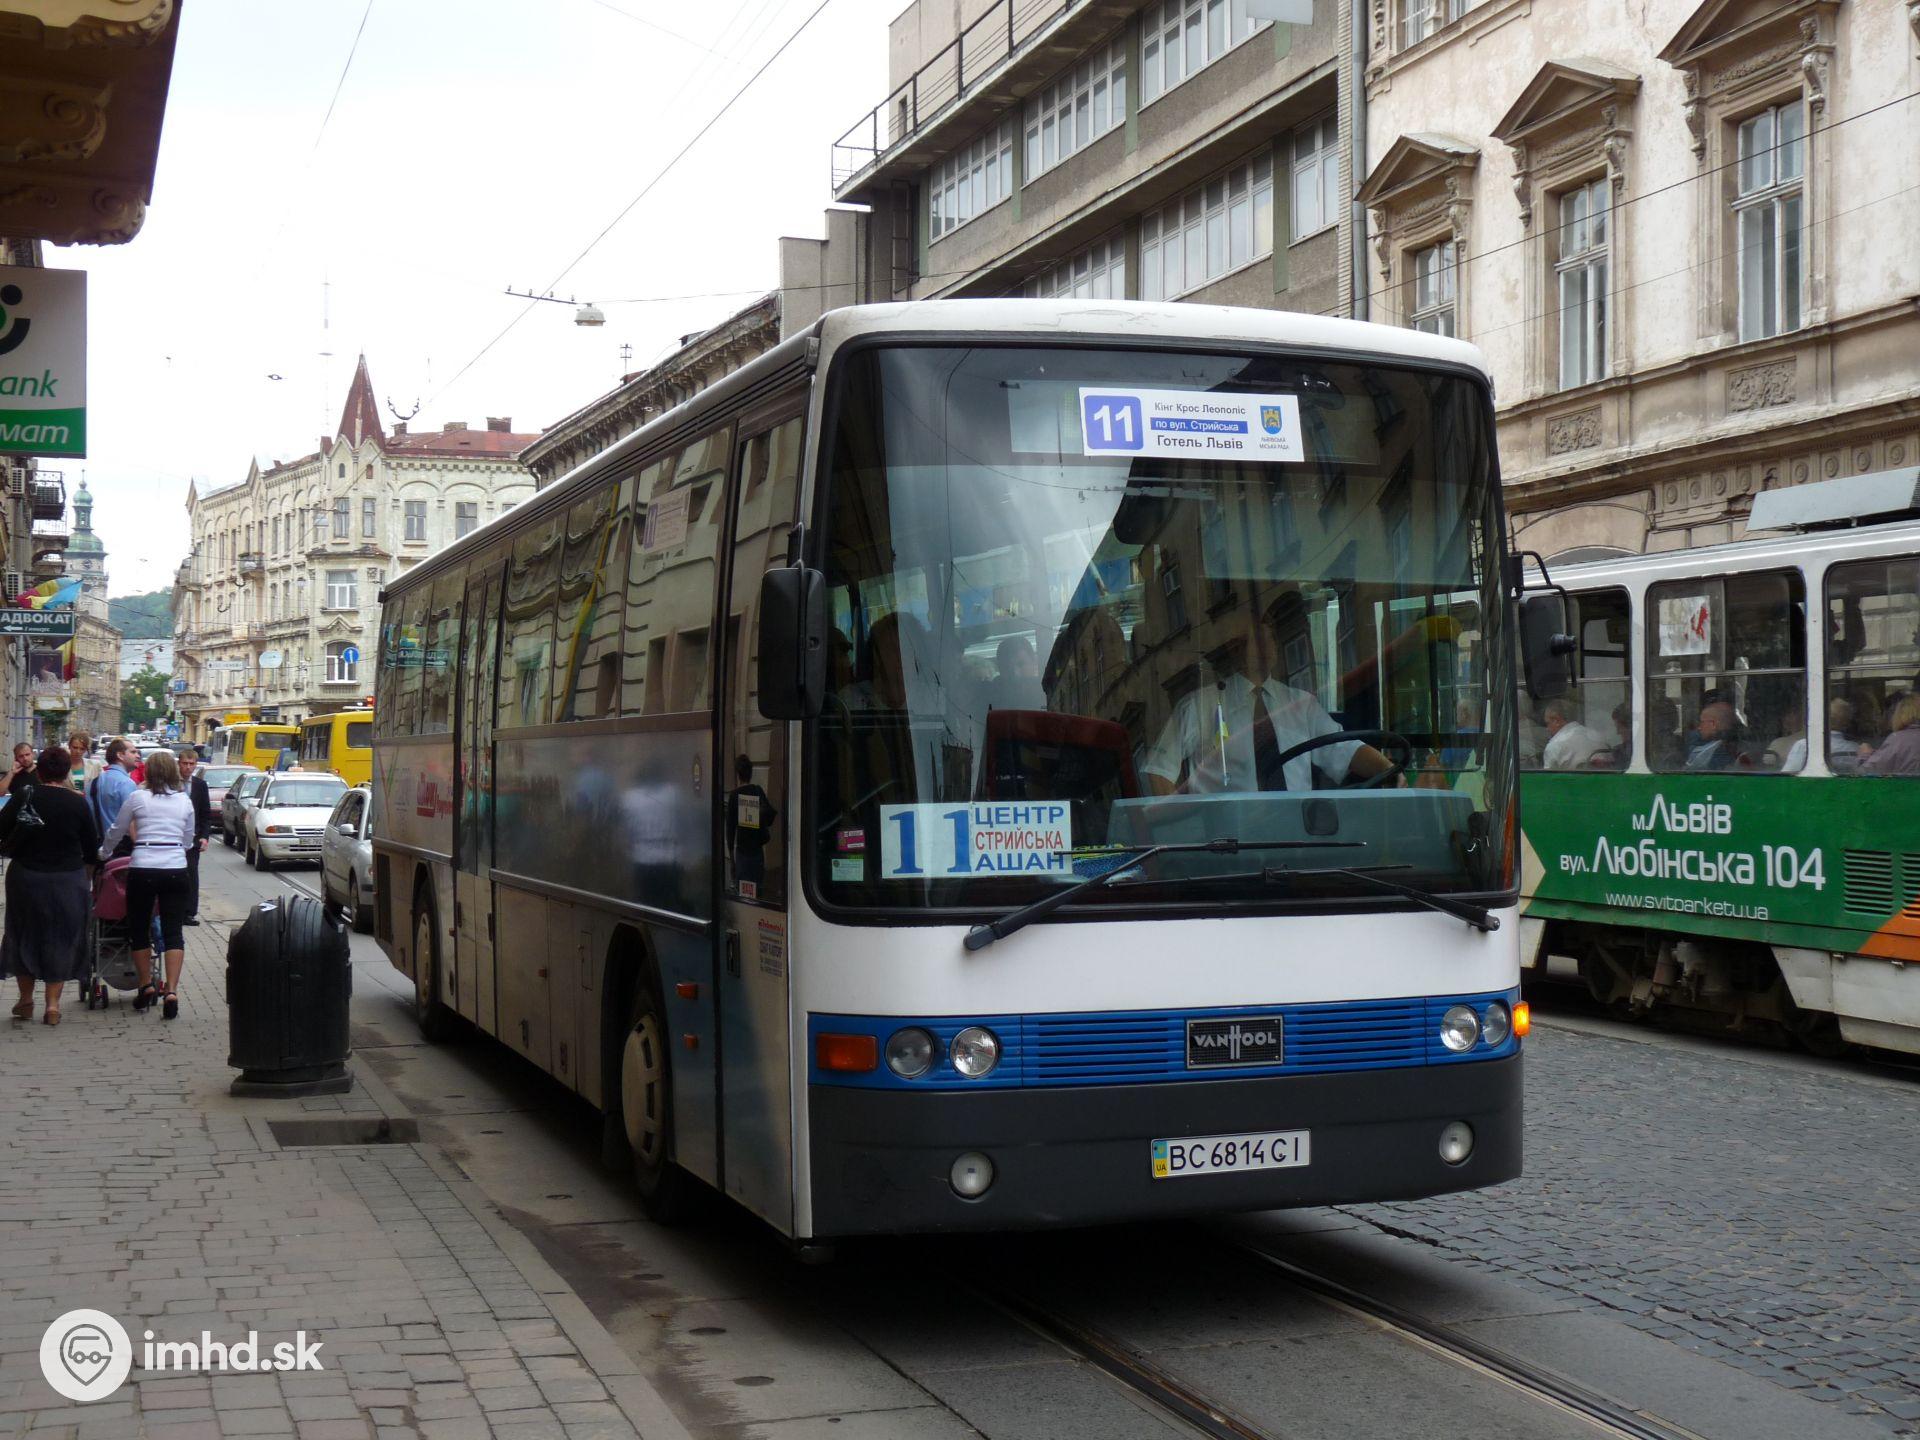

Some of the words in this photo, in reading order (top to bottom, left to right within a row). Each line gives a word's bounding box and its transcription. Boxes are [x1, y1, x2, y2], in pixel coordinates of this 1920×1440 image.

[1155, 402, 1173, 411] Кінг
[1176, 404, 1200, 413] Крос
[1202, 404, 1246, 415] Леополіс
[1093, 405, 1135, 443] 11
[1155, 421, 1167, 429] по
[1169, 422, 1189, 431] вул.
[1190, 421, 1239, 432] Стрийська
[1157, 435, 1202, 448] Готель
[1206, 437, 1243, 450] Львів
[0, 612, 71, 625] АДВОКАТ
[975, 806, 1064, 828] ЦЕНТР
[889, 810, 972, 875] 11
[975, 827, 1063, 850] СТРИЙСЬКА
[975, 852, 1064, 872] АШАН
[1762, 845, 1826, 891] 104
[1605, 892, 1769, 921] www.svitparketu.ua
[1156, 1164, 1167, 1172] UA
